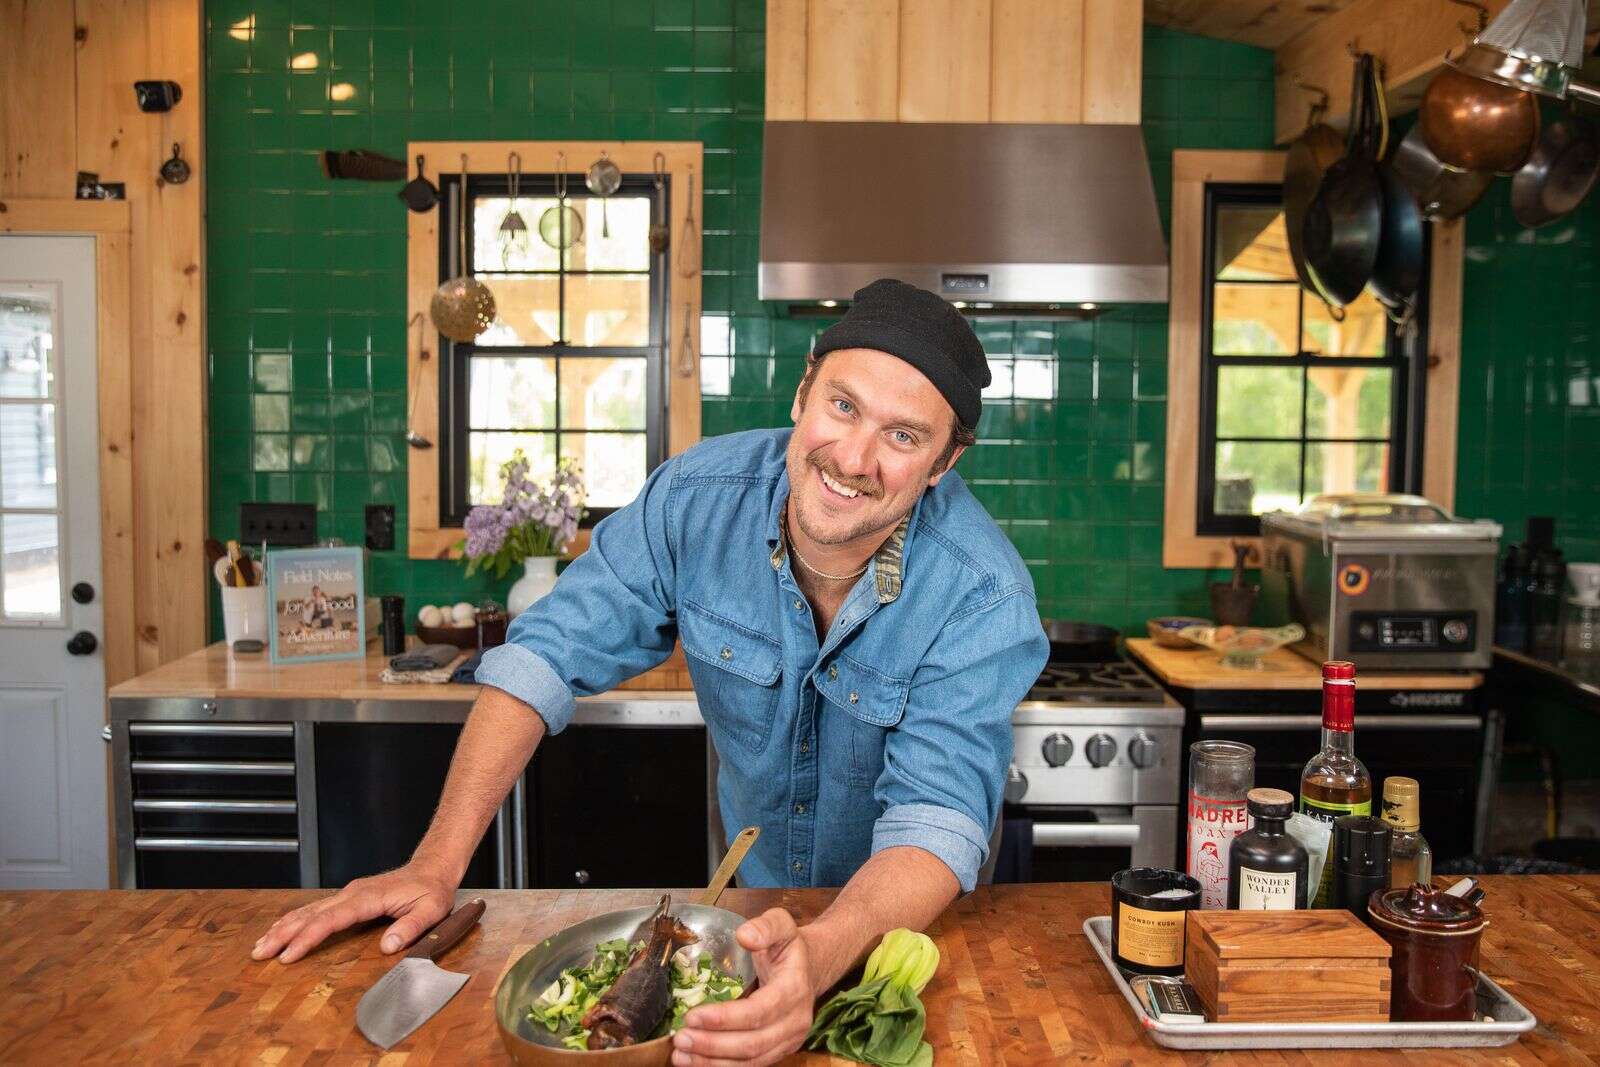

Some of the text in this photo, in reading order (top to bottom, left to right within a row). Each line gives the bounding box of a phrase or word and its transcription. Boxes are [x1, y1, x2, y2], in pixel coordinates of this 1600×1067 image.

[283, 567, 354, 584] Field Notes
[287, 629, 351, 643] Adventure
[1246, 874, 1290, 886] WONDER
[1247, 883, 1287, 894] VALLEY
[1128, 914, 1155, 926] COWBOY
